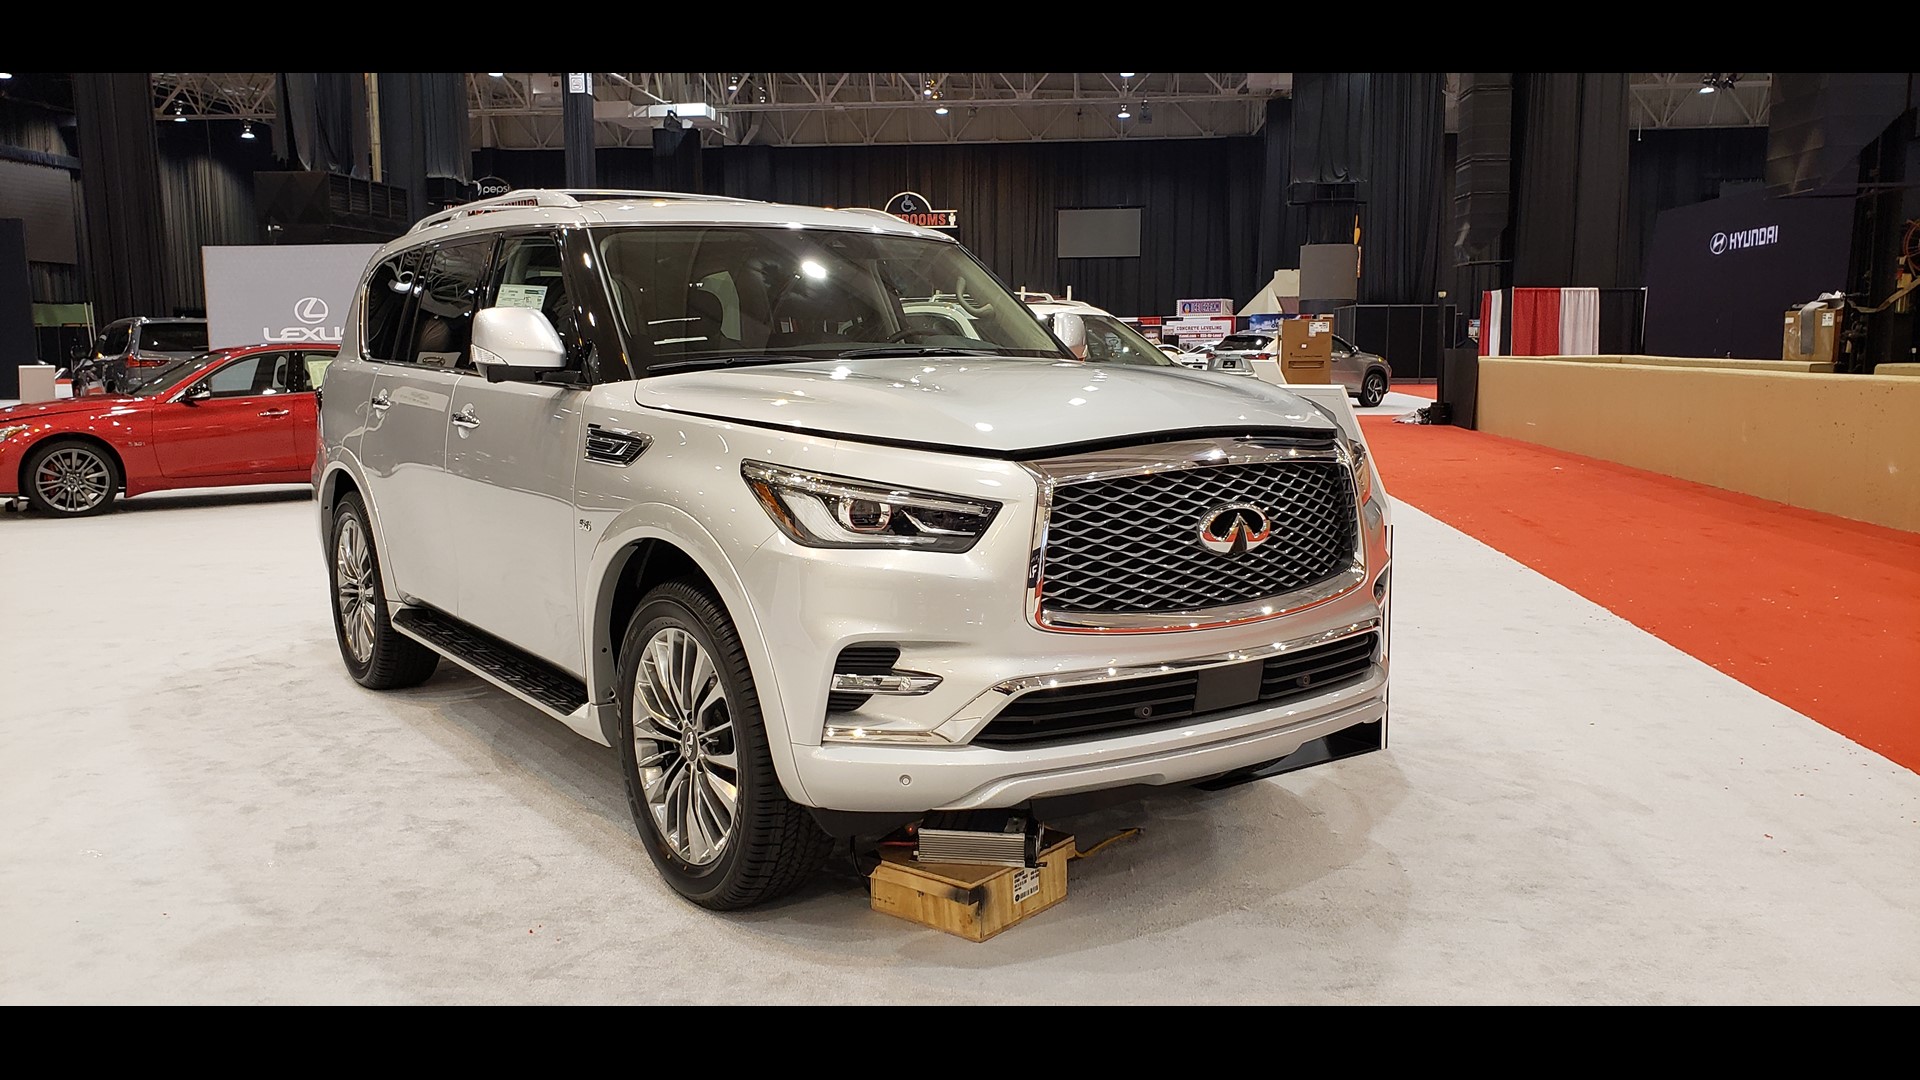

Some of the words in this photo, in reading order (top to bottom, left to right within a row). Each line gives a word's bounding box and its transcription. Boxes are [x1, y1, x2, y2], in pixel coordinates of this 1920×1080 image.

[482, 183, 511, 195] pepsi
[1728, 224, 1779, 250] HYUNDAI
[263, 326, 345, 342] LEXU
